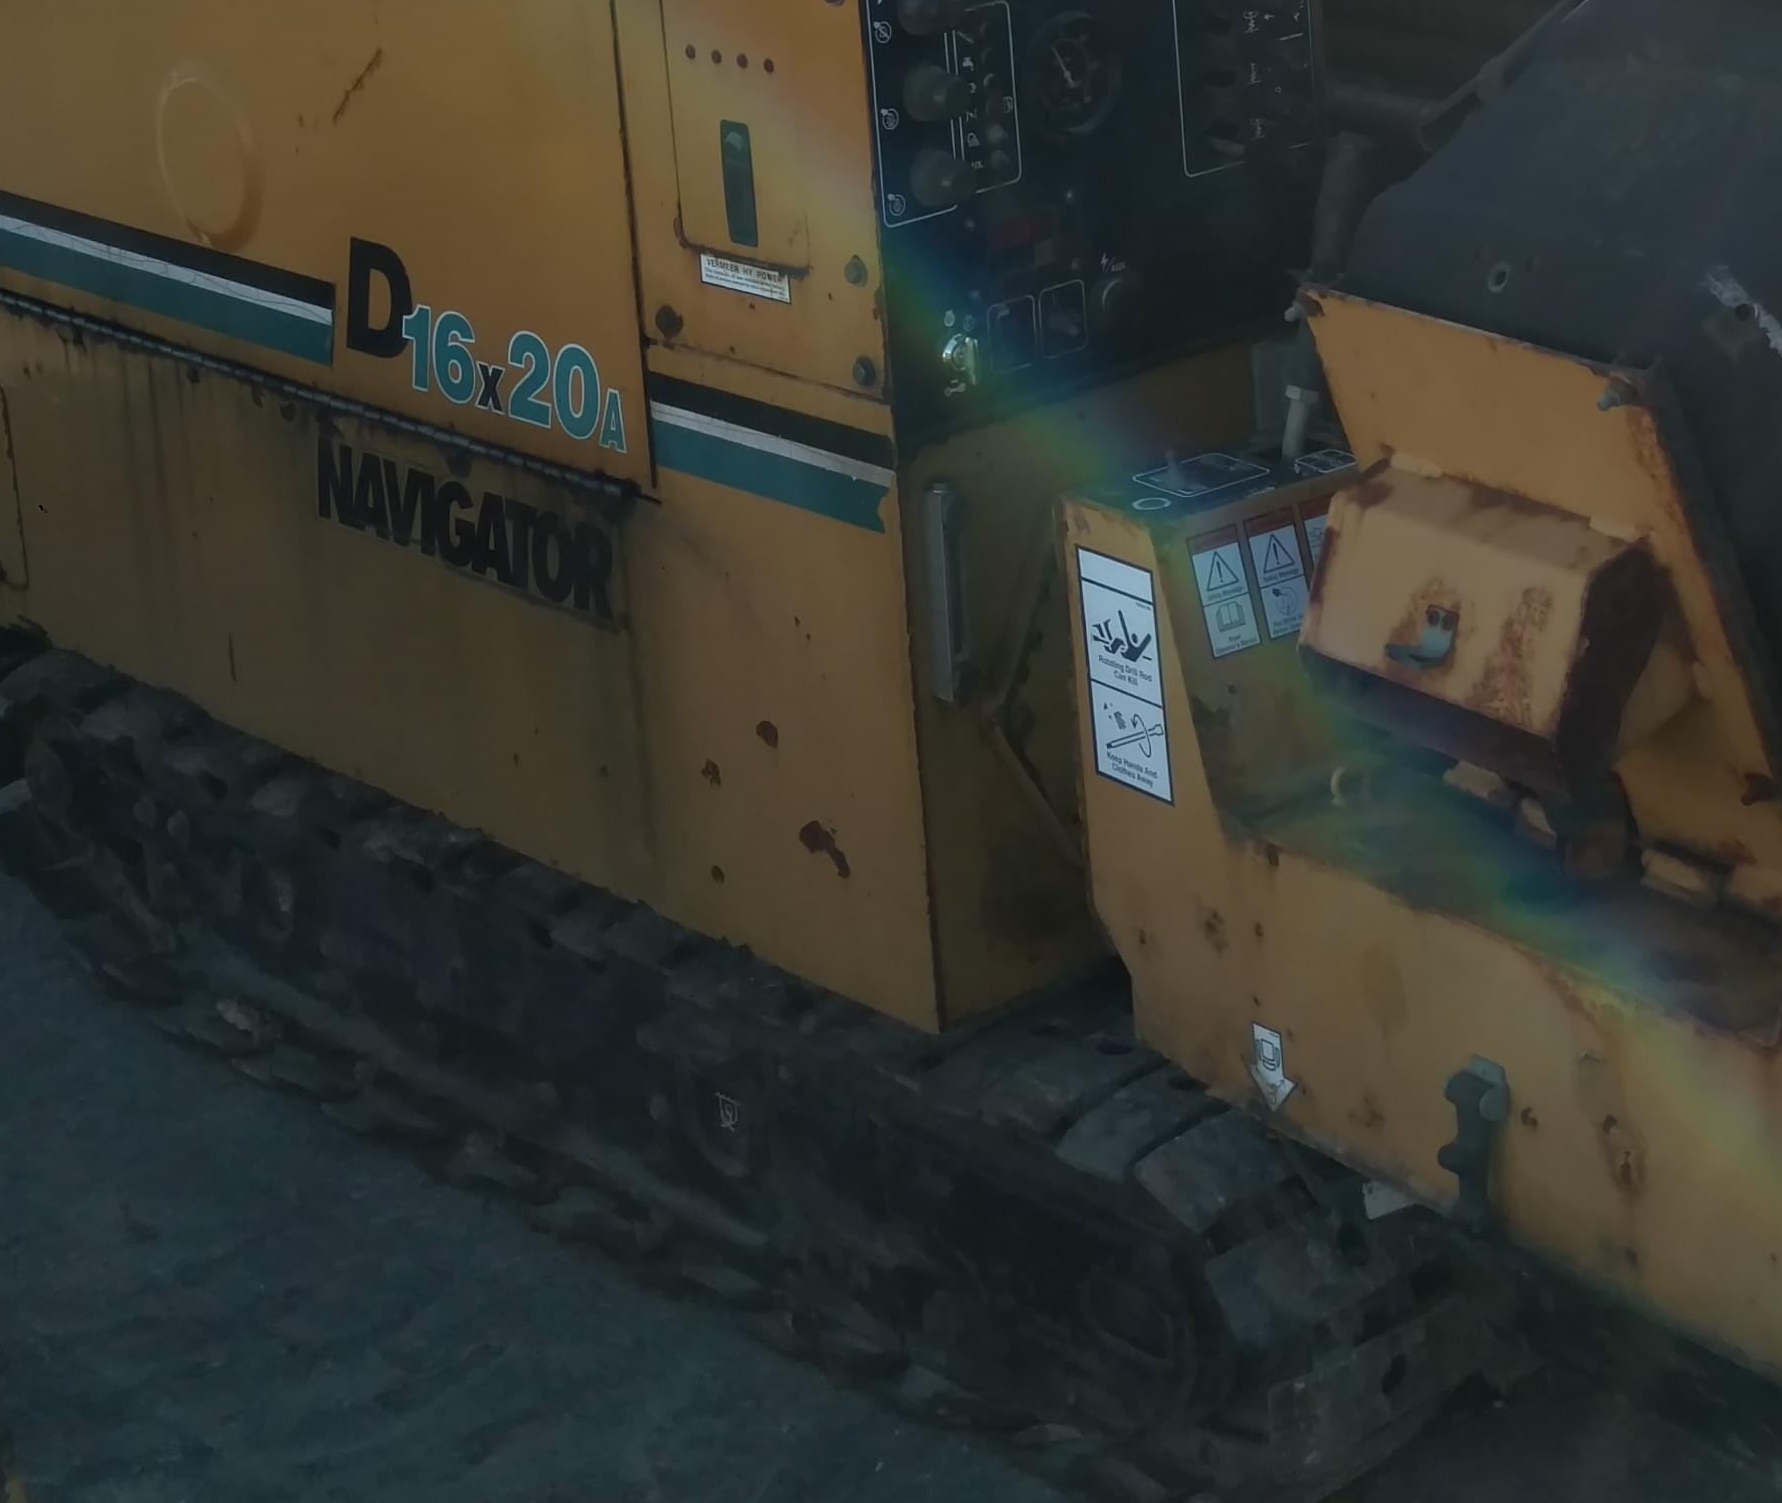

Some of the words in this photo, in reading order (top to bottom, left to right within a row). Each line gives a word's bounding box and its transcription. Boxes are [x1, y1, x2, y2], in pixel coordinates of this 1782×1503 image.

[318, 435, 615, 620] NAVIGATOR
[1099, 655, 1125, 674] Rotating
[1107, 751, 1123, 765] Keep
[1123, 758, 1143, 773] Hands
[1112, 762, 1136, 779] Clothes
